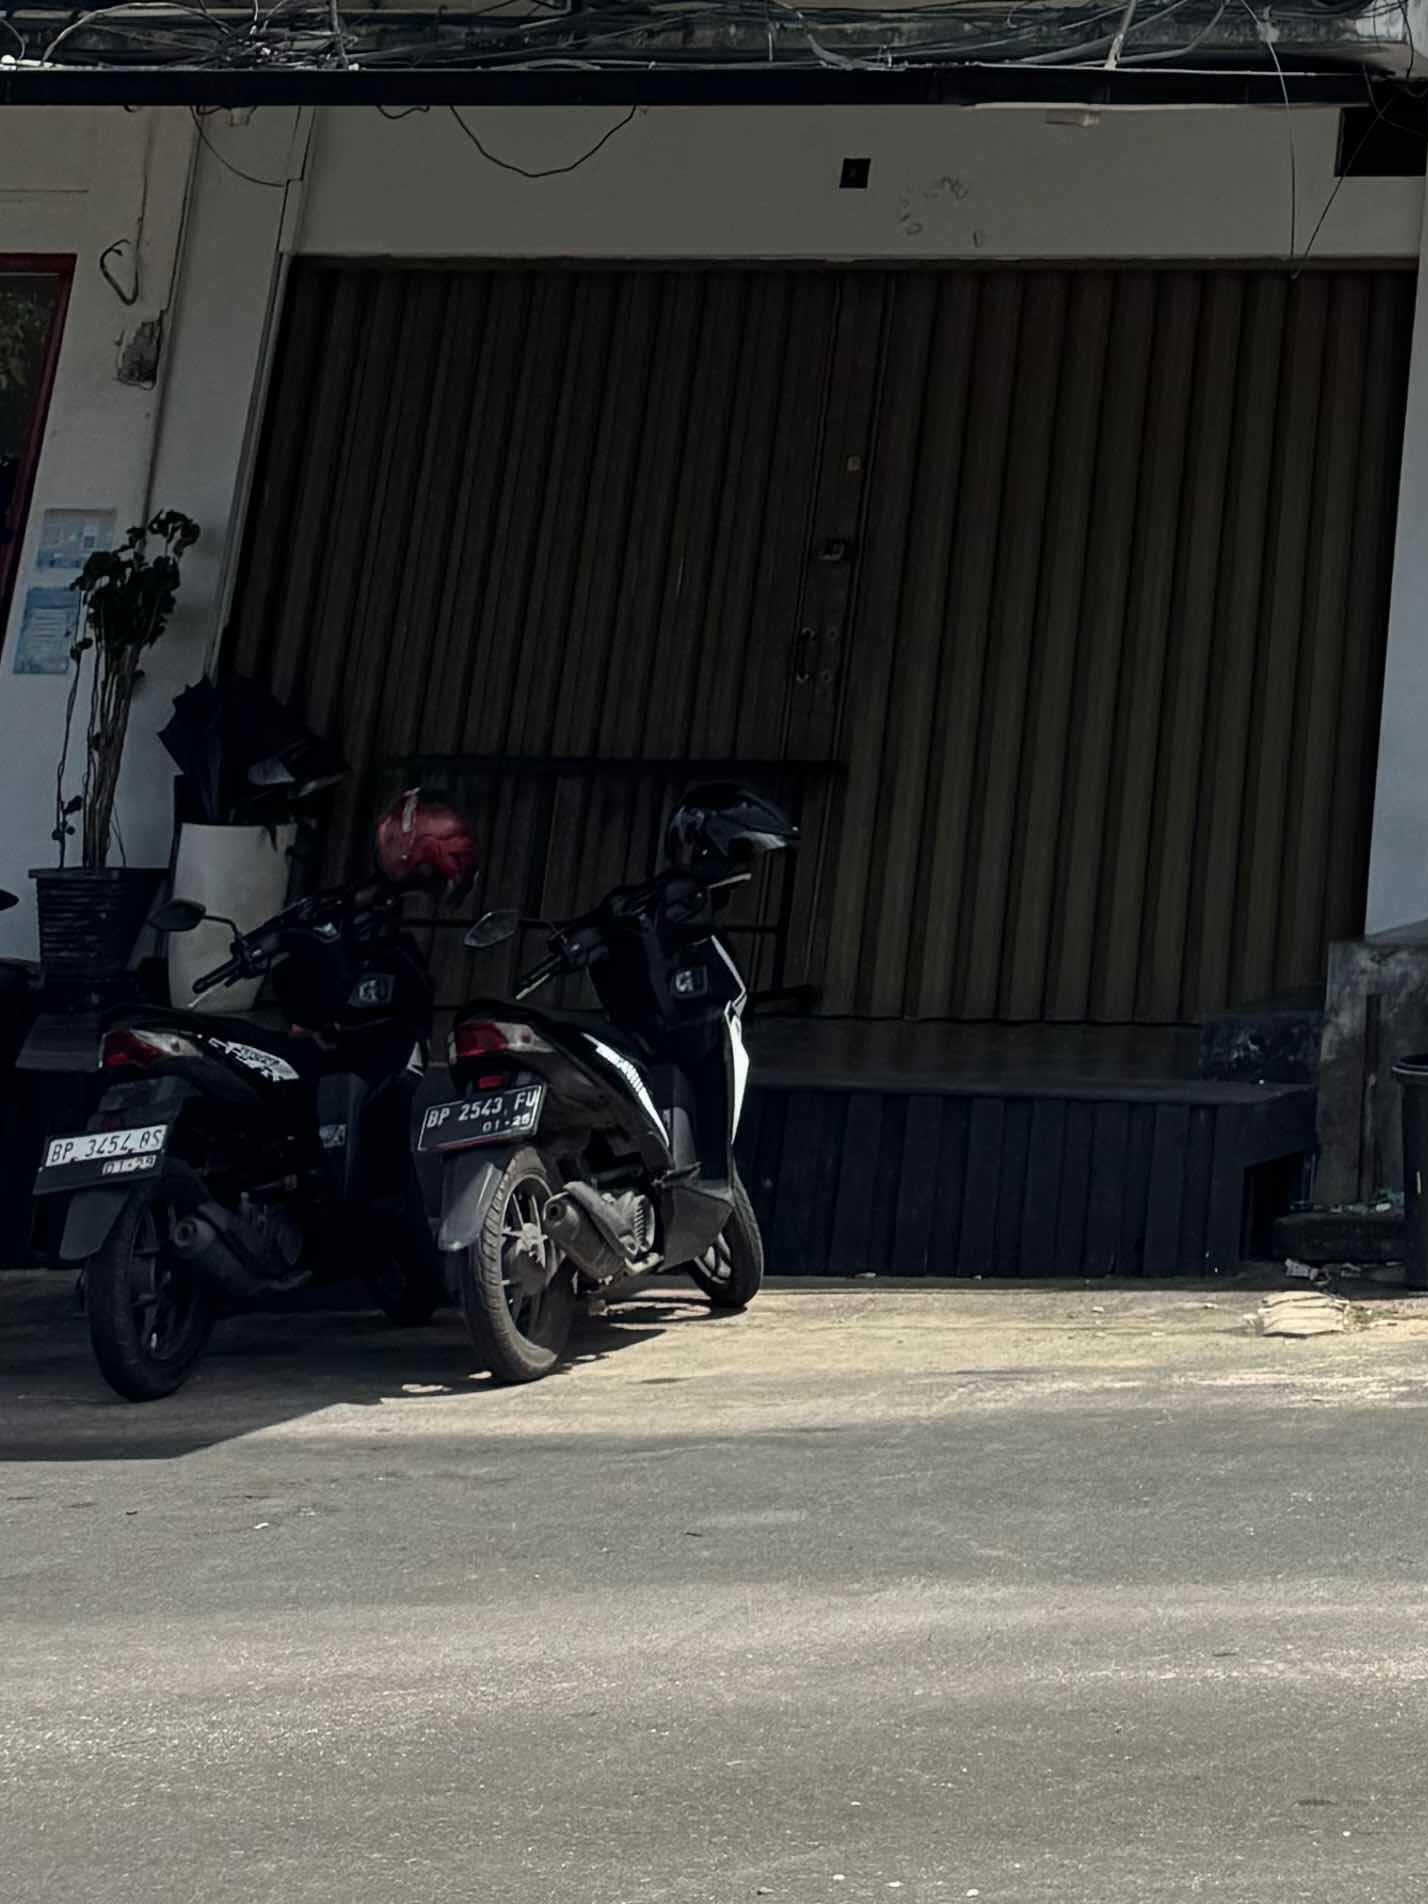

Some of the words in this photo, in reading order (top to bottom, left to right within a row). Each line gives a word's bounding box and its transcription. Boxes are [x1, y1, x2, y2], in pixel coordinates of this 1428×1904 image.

[426, 1106, 451, 1129] BP
[457, 1096, 504, 1122] 2543
[513, 1088, 537, 1111] FU
[51, 1141, 75, 1163] BP
[85, 1132, 132, 1158] 3454
